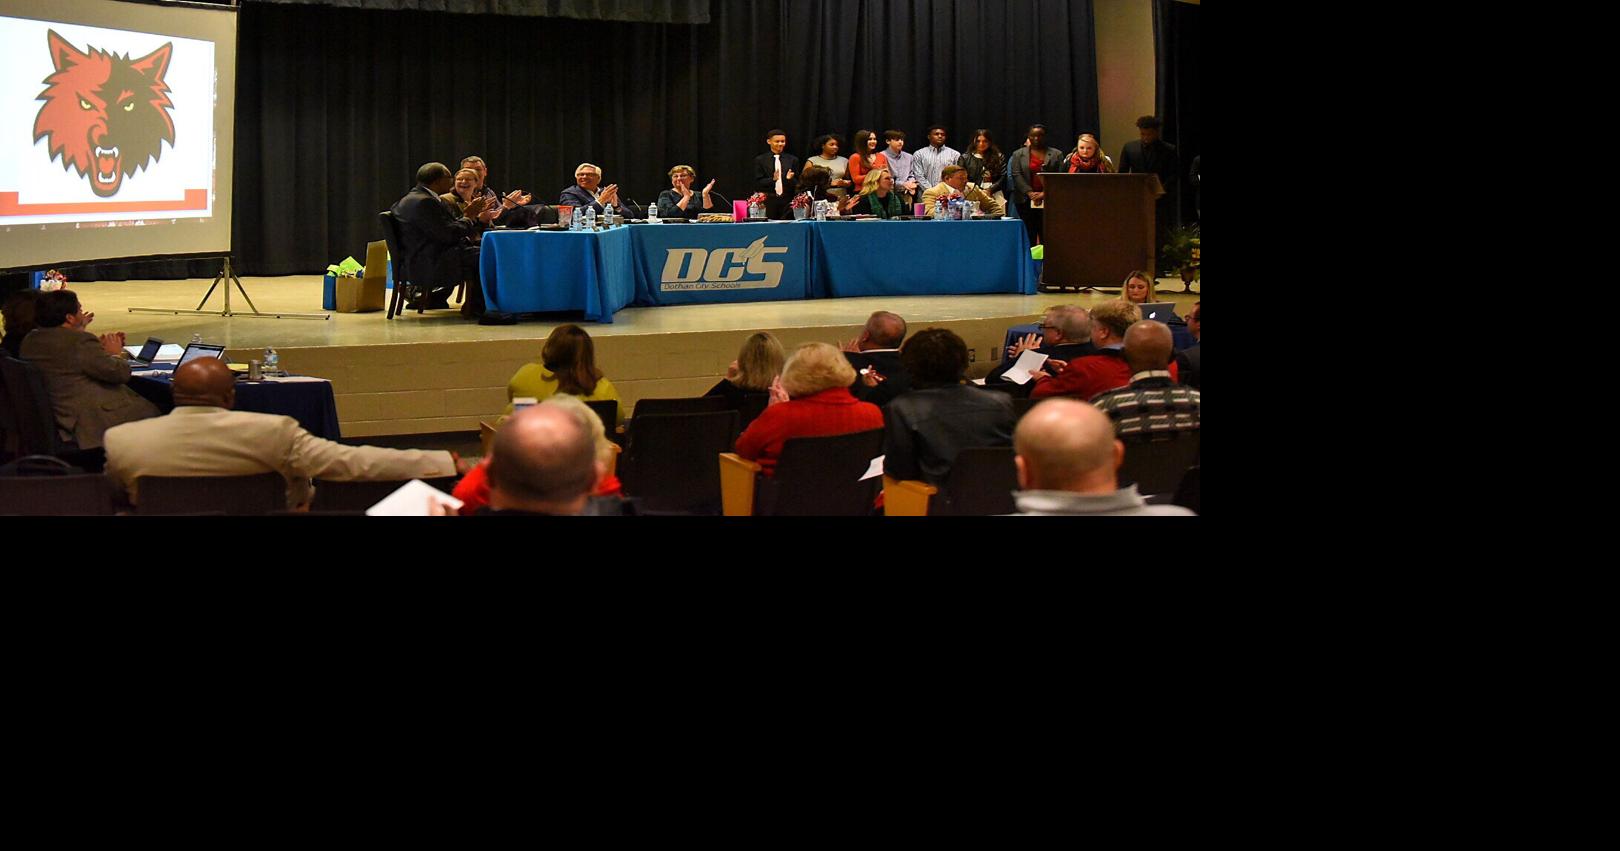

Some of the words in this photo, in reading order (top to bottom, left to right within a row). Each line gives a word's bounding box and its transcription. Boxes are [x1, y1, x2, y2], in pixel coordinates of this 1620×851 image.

[661, 246, 788, 289] DCS
[695, 282, 709, 290] City
[711, 281, 741, 289] Schools
